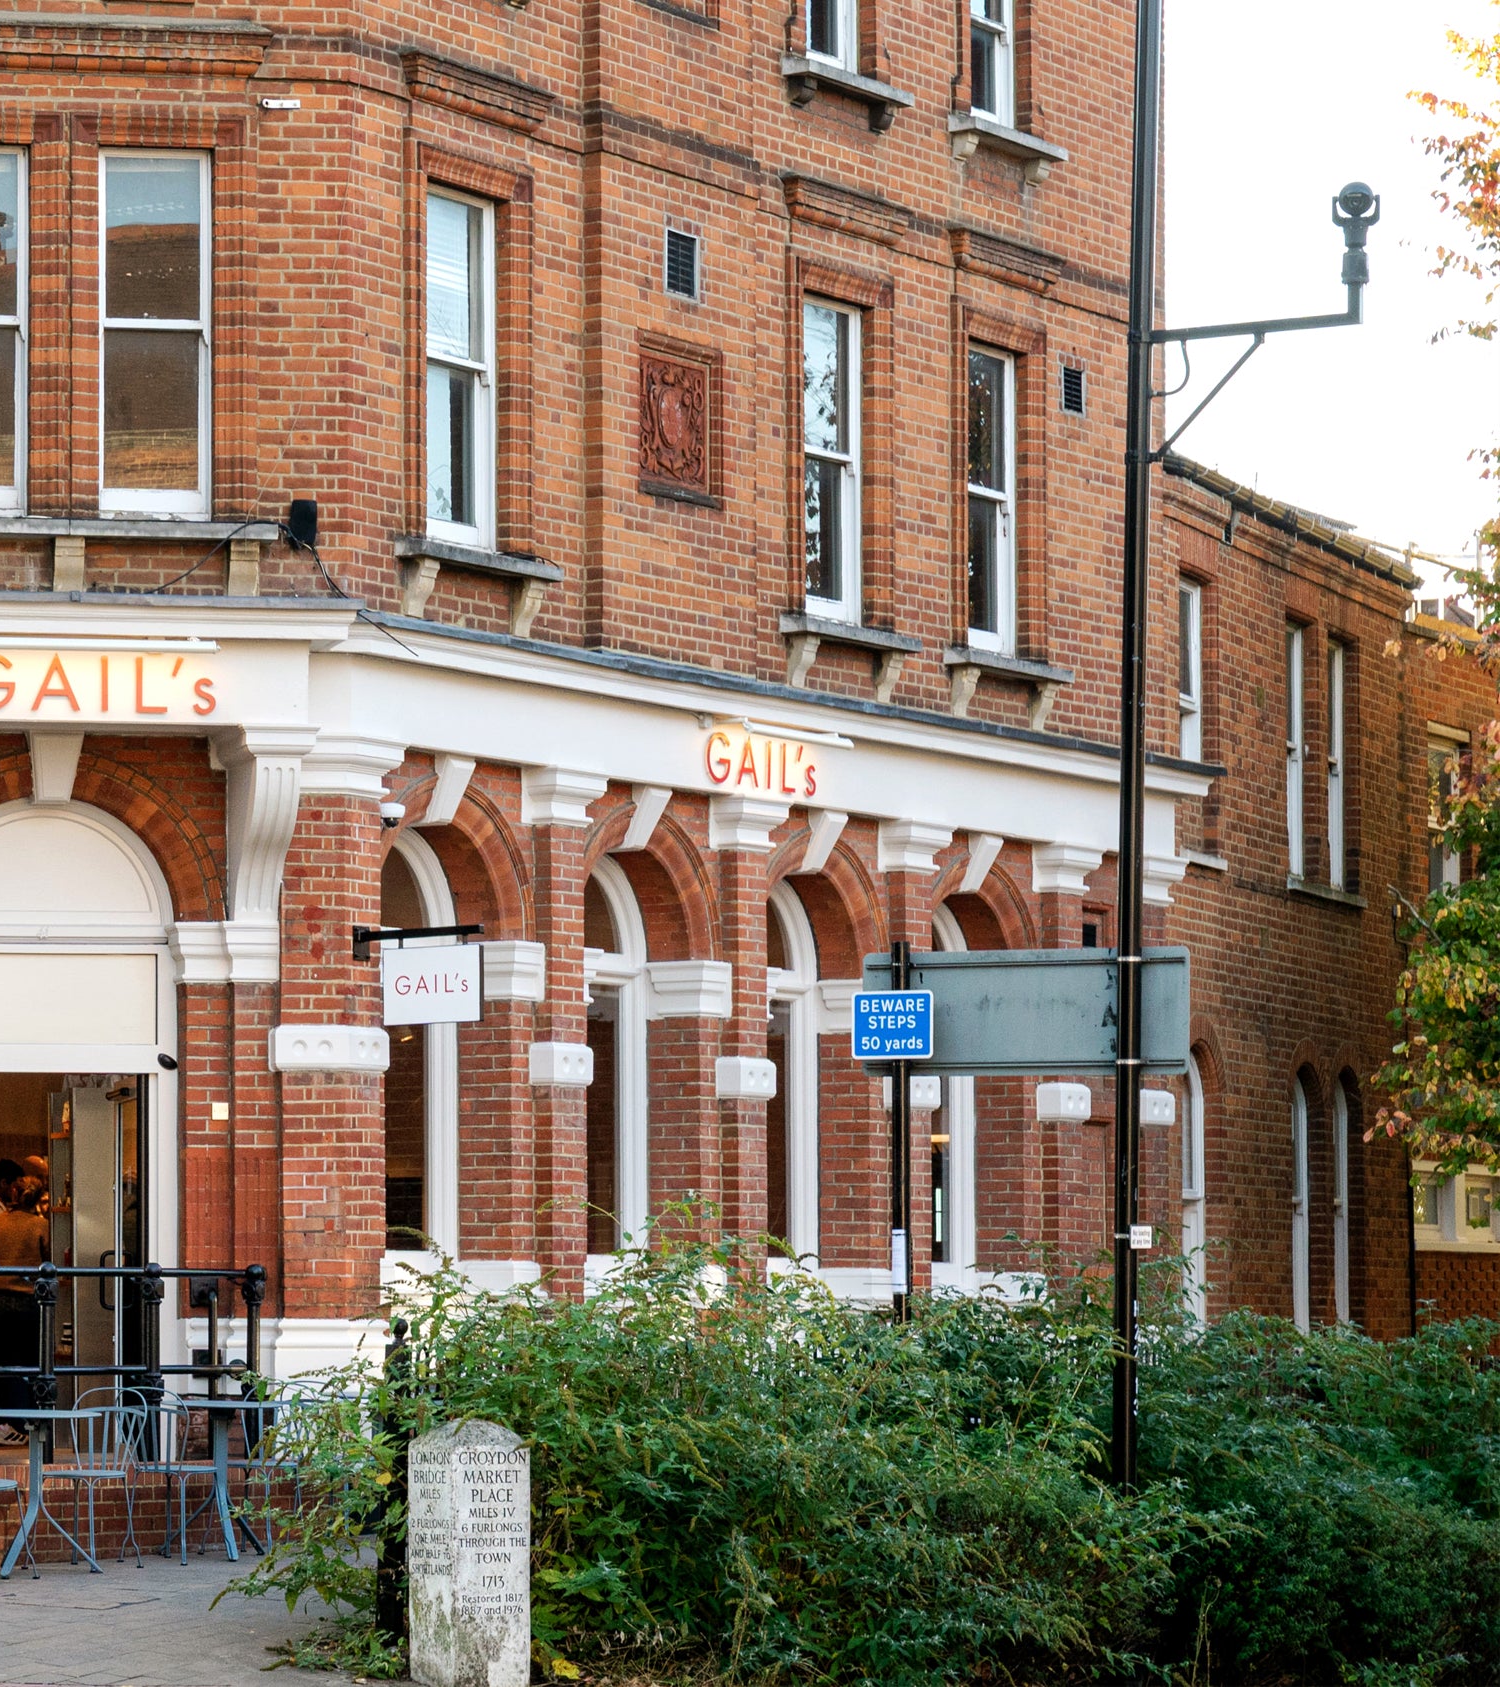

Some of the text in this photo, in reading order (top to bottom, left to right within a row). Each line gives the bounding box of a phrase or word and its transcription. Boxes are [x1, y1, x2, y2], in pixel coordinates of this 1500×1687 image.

[706, 732, 817, 797] GAIL's
[394, 973, 469, 996] GAIL's
[860, 998, 925, 1013] BEWARE
[868, 1015, 917, 1030] STEPS
[861, 1036, 924, 1053] 50 yards
[410, 1451, 451, 1465] LONDON
[458, 1451, 526, 1466] CROYDON
[413, 1469, 447, 1484] BRIDGE
[463, 1470, 521, 1484] MARKET
[420, 1489, 441, 1500] MILES
[471, 1488, 513, 1503] PLACE
[469, 1507, 516, 1518] MILES IV
[461, 1523, 523, 1533] 6 FURLONGS
[458, 1537, 527, 1548] THROUGH THE
[475, 1552, 512, 1564] TOWN
[482, 1575, 505, 1591] 1713
[462, 1594, 501, 1604] Restored
[483, 1605, 501, 1616] and
[504, 1604, 524, 1615] 1976
